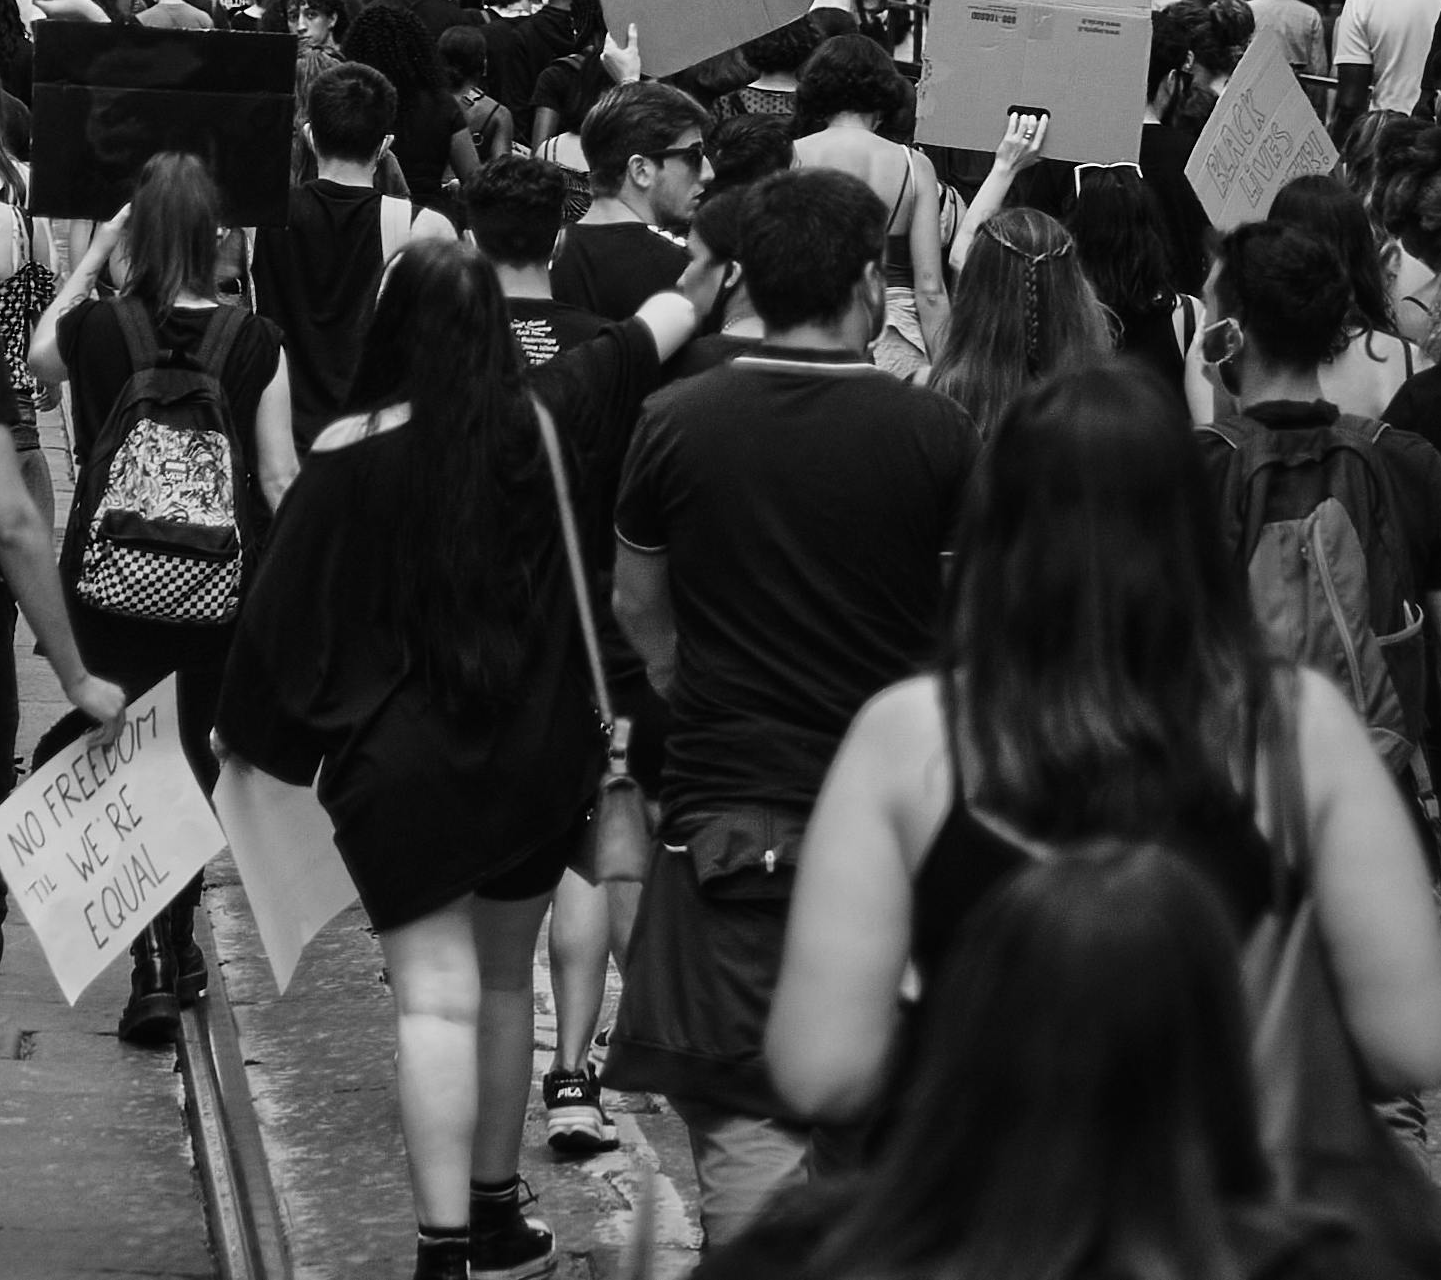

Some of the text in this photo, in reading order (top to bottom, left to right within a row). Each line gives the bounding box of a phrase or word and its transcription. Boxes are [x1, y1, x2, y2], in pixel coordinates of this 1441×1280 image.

[1207, 89, 1265, 199] BLACK
[7, 705, 157, 867] NO FREEDOM
[83, 842, 171, 950] EQUAL
